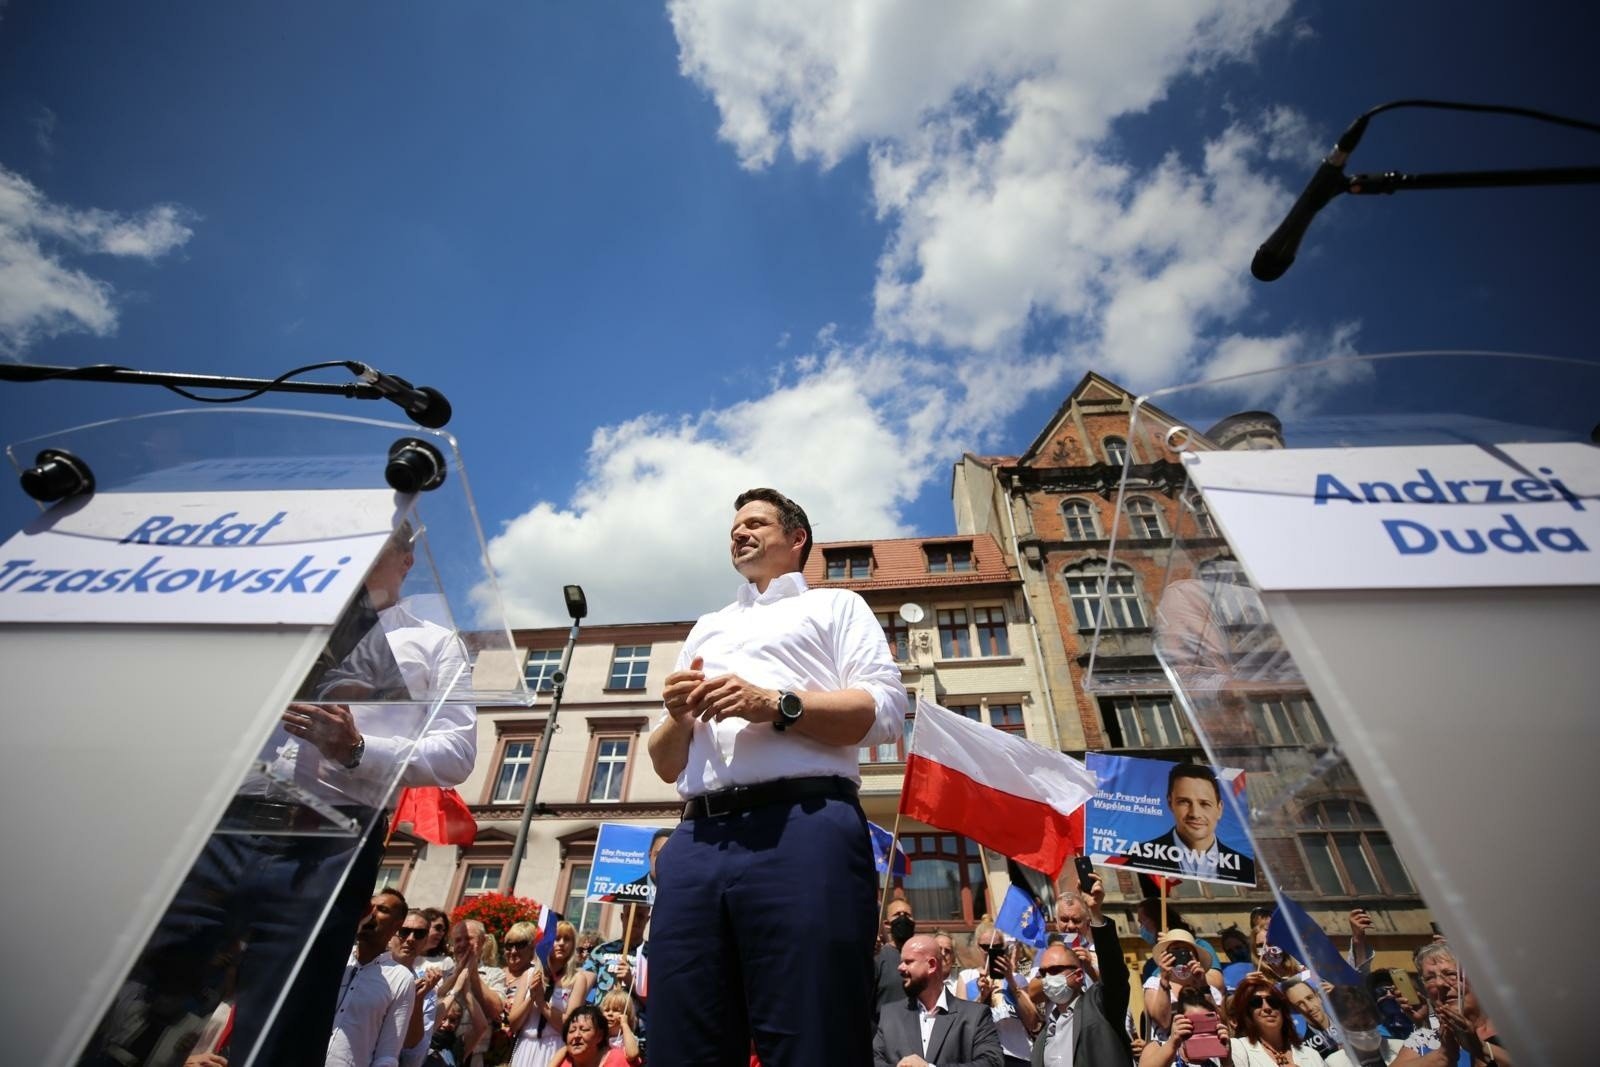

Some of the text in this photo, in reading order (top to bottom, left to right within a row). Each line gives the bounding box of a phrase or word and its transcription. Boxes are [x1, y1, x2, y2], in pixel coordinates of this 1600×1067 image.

[1314, 467, 1587, 511] Andrzej
[118, 511, 288, 546] Rafał
[1382, 514, 1590, 555] Duda
[0, 556, 352, 594] Trzaskowski
[1094, 800, 1162, 815] Wspólna Polska
[1116, 792, 1160, 804] Prezydent
[1093, 836, 1240, 870] TRZASKOWSKI
